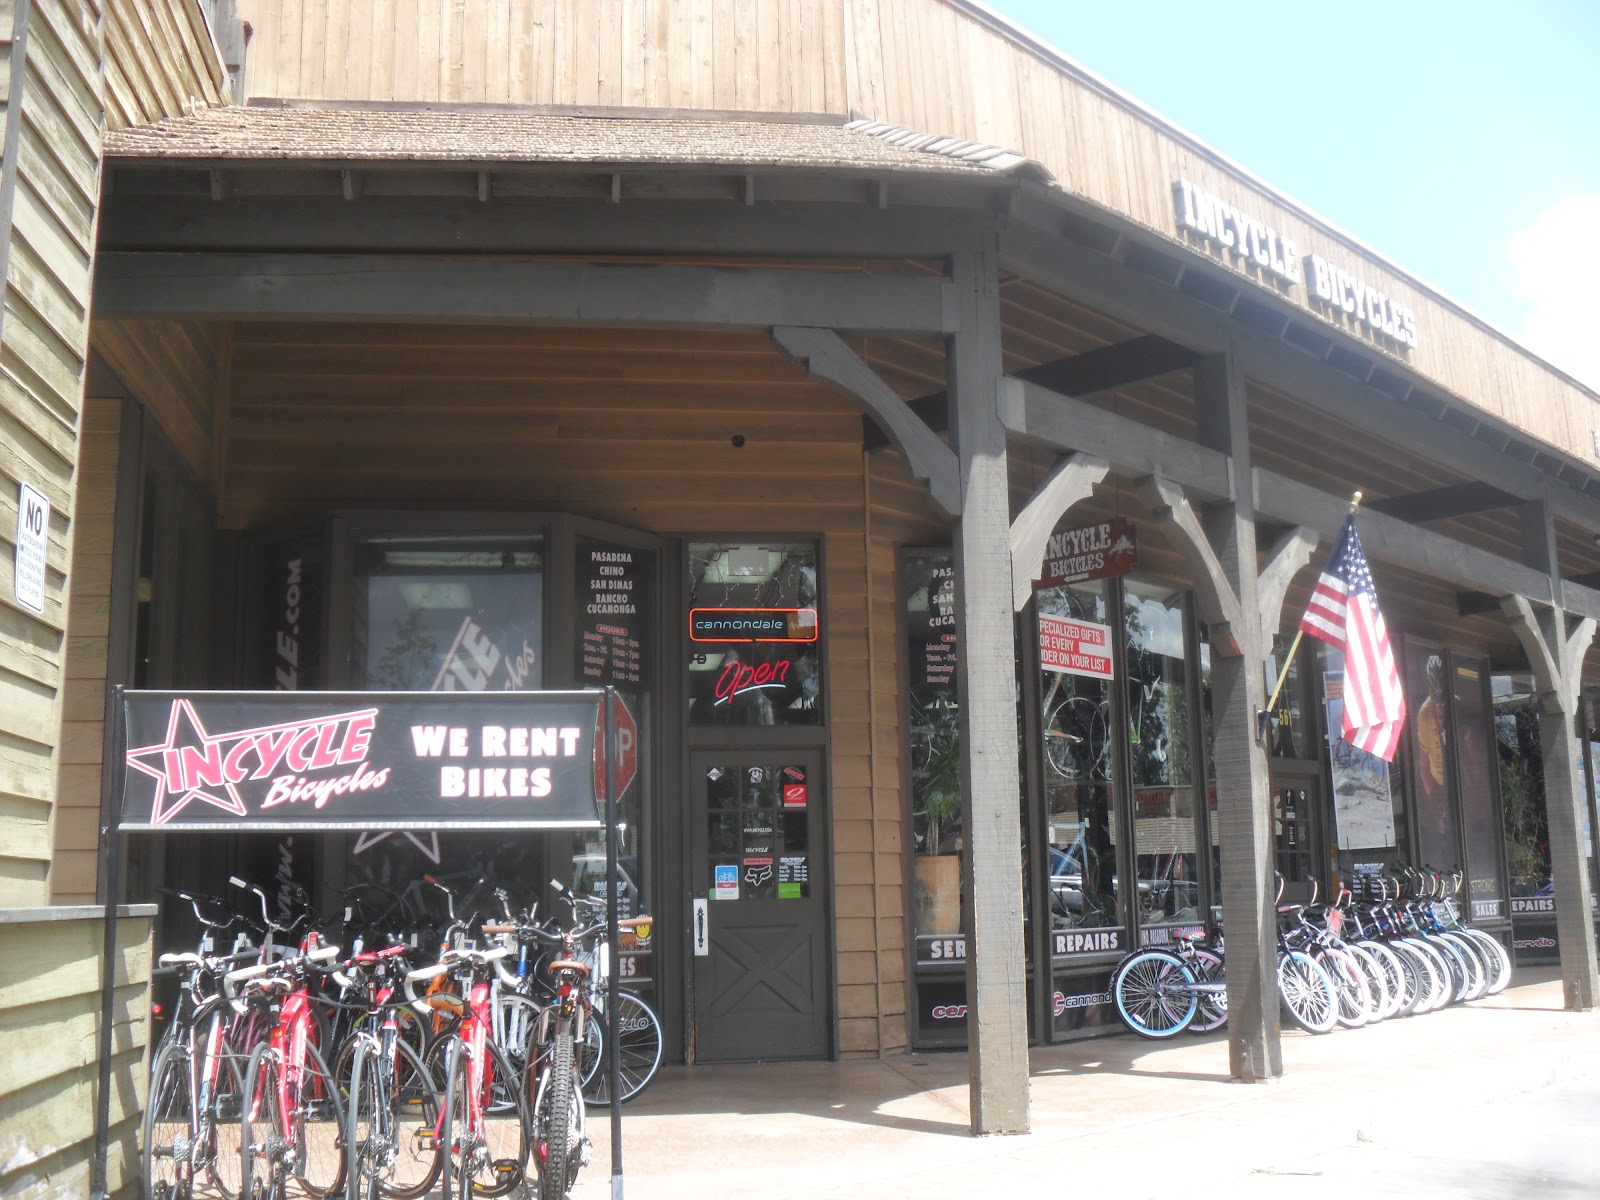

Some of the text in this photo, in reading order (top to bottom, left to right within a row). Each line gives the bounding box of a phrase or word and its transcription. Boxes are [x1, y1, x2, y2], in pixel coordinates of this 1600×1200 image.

[1175, 178, 1418, 349] INCYCLE BICYCLES
[26, 499, 42, 536] NO
[1046, 524, 1111, 560] NCYCLE
[591, 551, 632, 563] PASADENA
[1050, 552, 1104, 577] BICYCLES
[599, 566, 624, 576] CHINO
[932, 567, 955, 578] PAS
[590, 580, 633, 590] SAN DIMAS
[596, 594, 628, 604] RANCHO
[587, 604, 636, 614] CUCAMONGA
[599, 625, 625, 635] HOURS
[696, 619, 783, 630] cannondale
[929, 617, 956, 627] CUCA
[1040, 619, 1101, 643] PECIALIZED GIFTS
[1040, 634, 1074, 652] OR EVERY
[1041, 649, 1105, 671] IDER ON YOUR LIST
[715, 660, 790, 704] Open
[411, 725, 469, 757] WE
[481, 725, 581, 757] RENT
[163, 712, 377, 792] INCYCLE
[260, 762, 391, 809] Bicycles
[441, 766, 552, 798] BIKES
[1475, 904, 1497, 917] SALES
[1512, 899, 1554, 912] EPAIRS
[931, 940, 965, 959] SER
[1056, 932, 1118, 954] REPAIRS
[1514, 937, 1556, 948] ervélo
